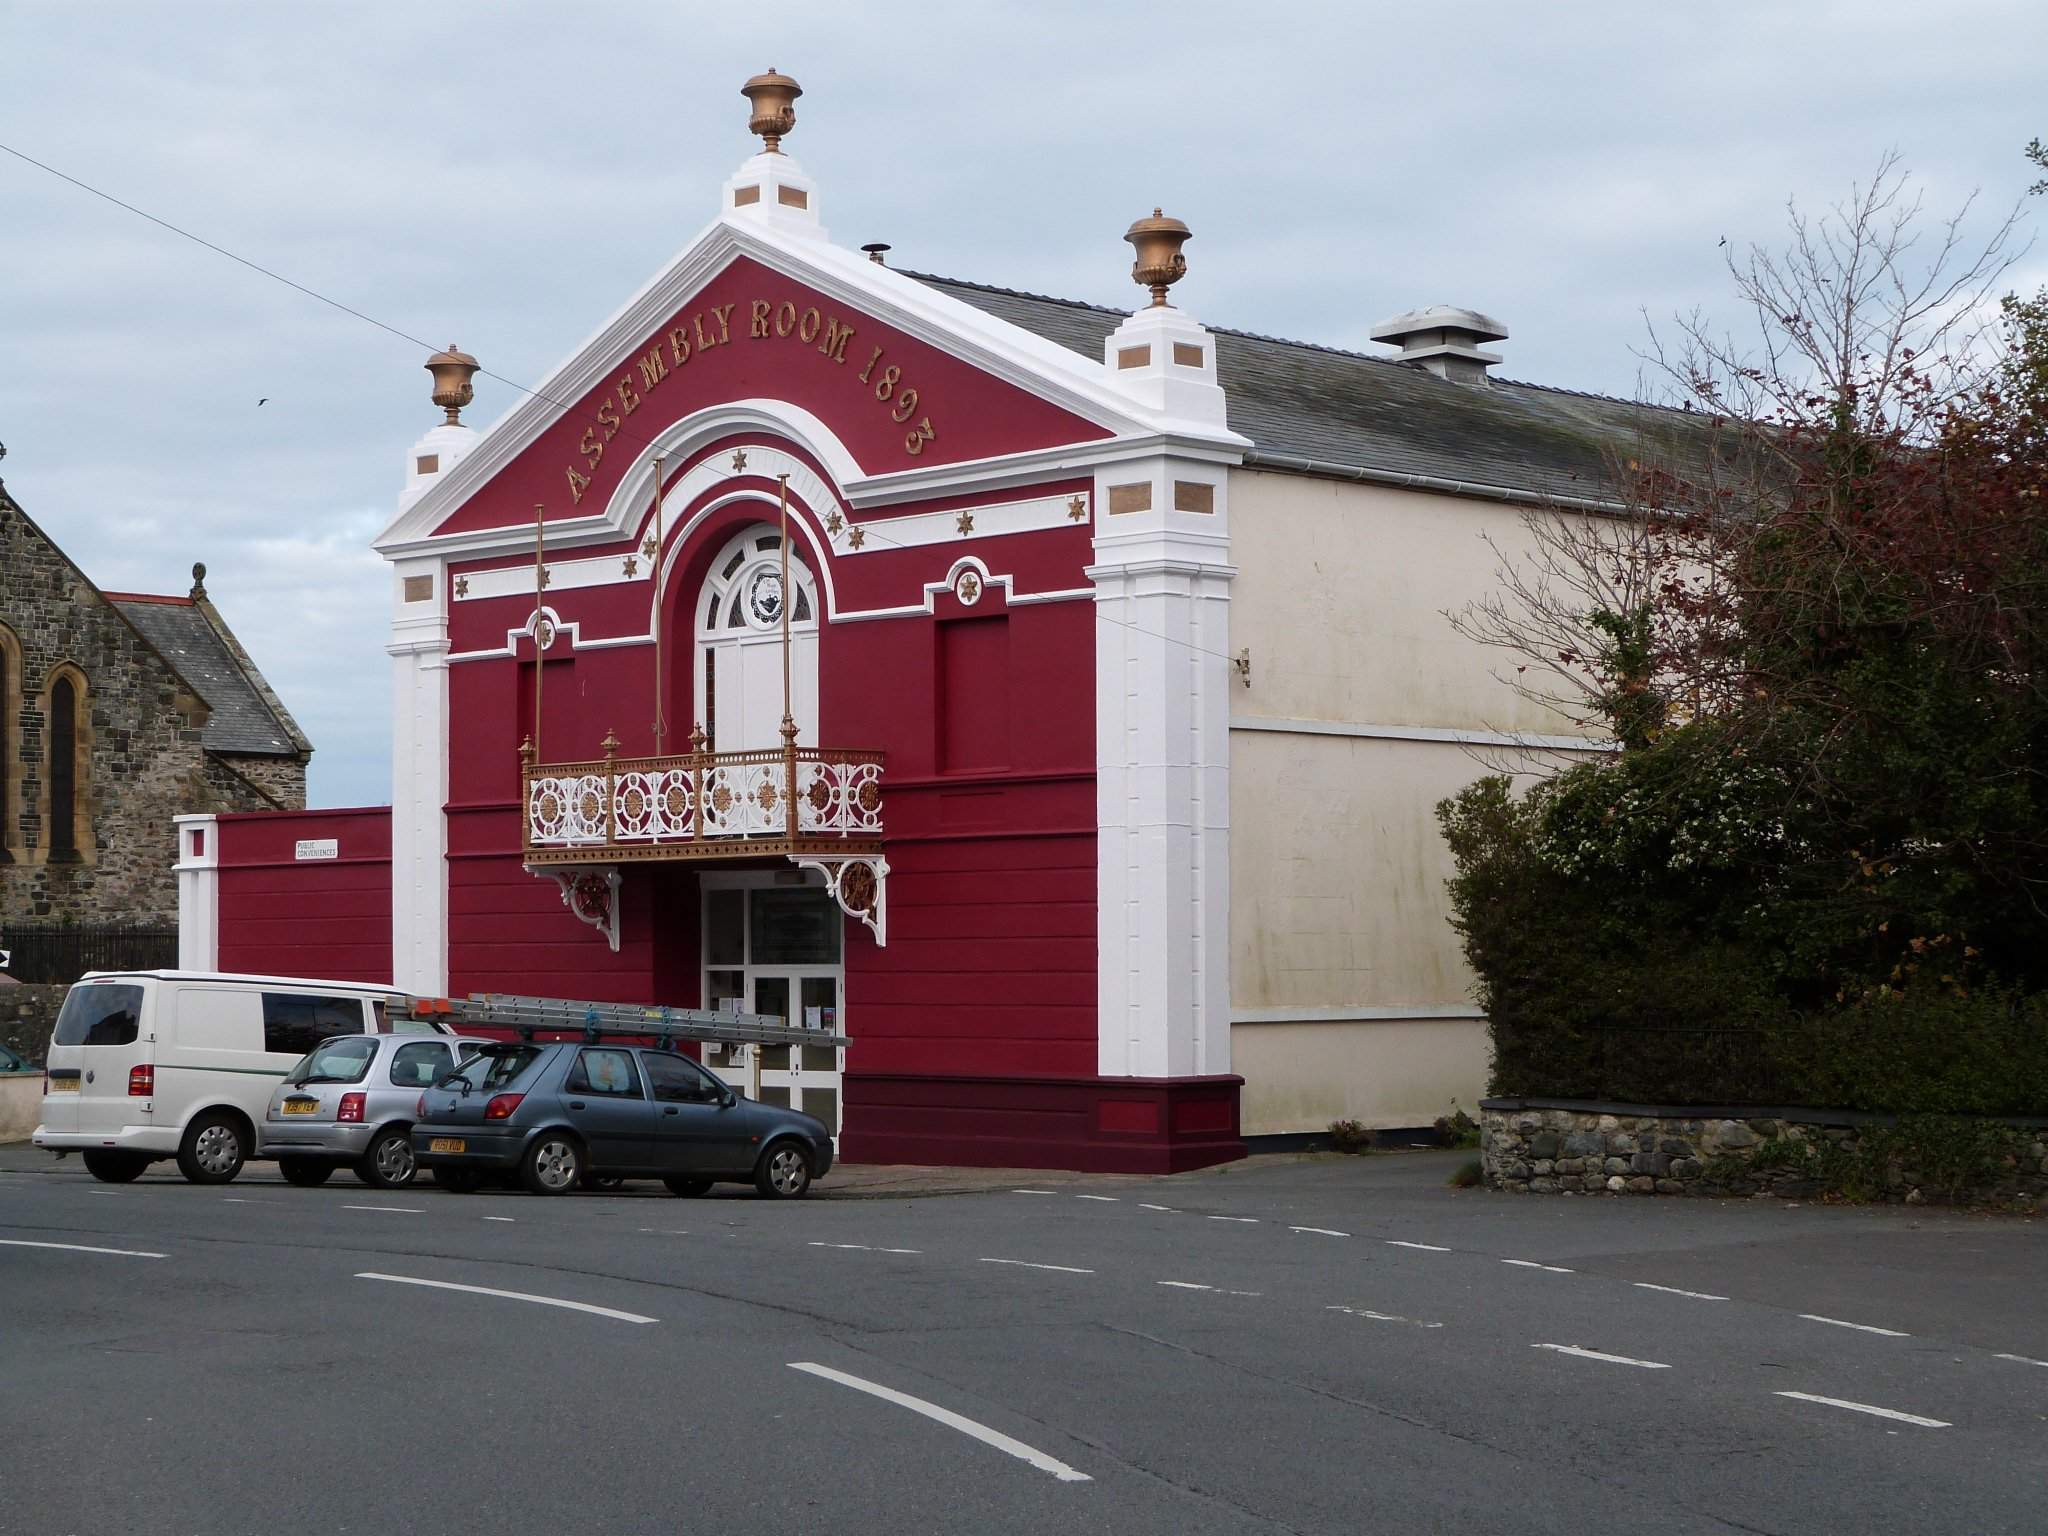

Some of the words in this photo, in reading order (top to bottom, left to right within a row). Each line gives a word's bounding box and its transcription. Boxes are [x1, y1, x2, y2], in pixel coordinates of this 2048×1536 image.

[566, 304, 735, 503] ASSEMBLY
[750, 299, 855, 364] ROOM
[859, 346, 936, 455] 1893
[297, 849, 336, 857] CONVENIENCES
